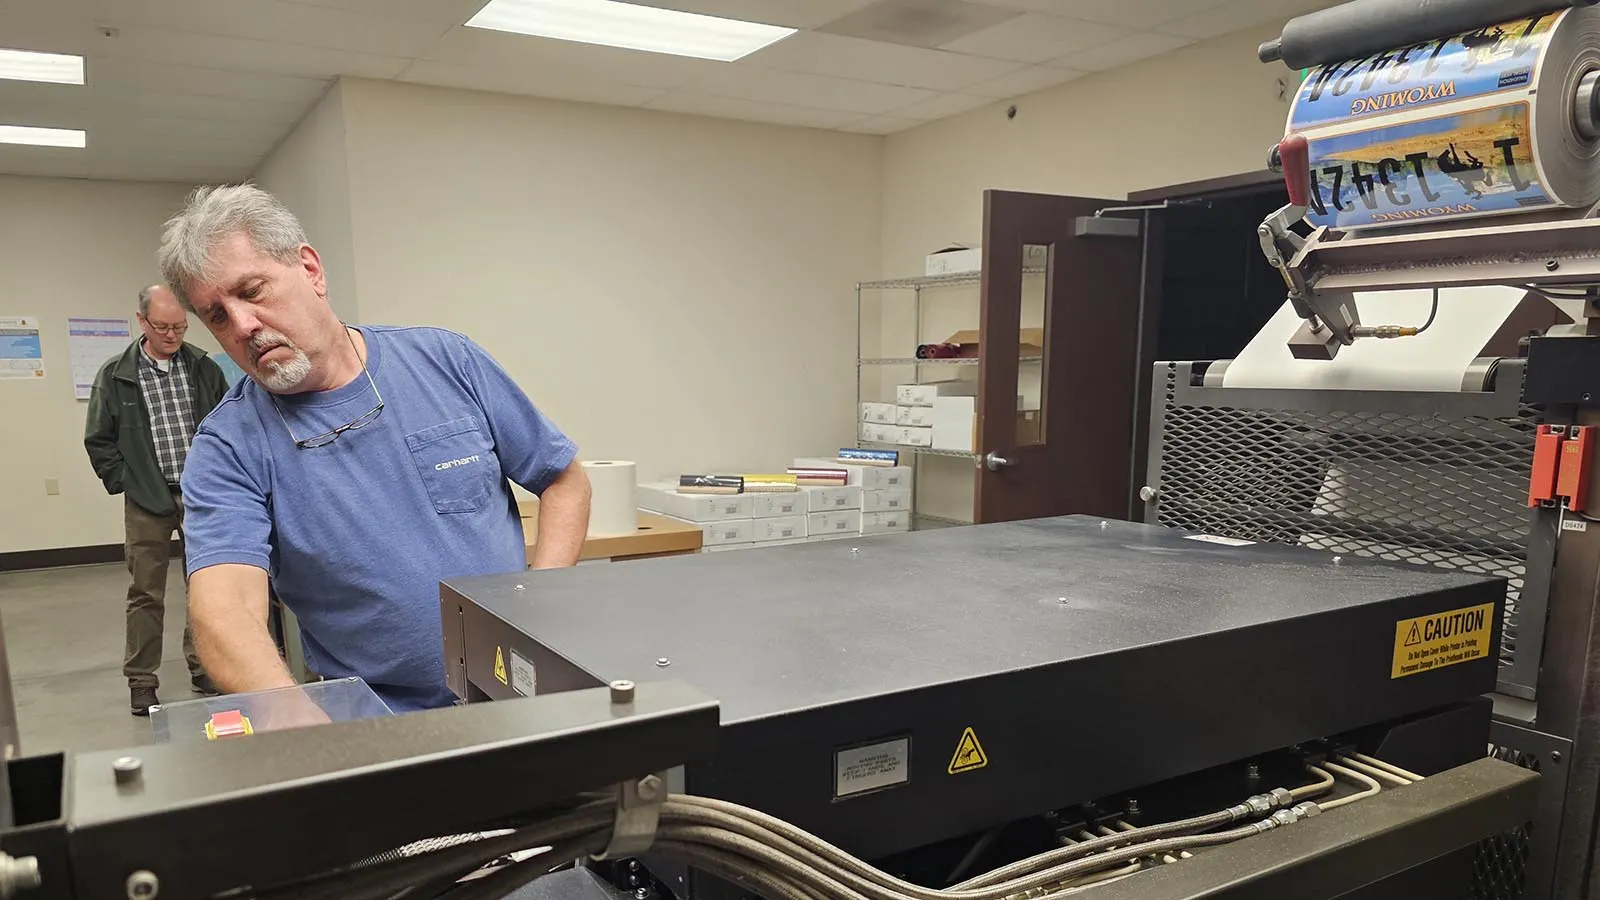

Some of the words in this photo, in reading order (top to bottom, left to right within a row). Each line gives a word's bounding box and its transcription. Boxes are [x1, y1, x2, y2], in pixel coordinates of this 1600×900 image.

[1351, 80, 1457, 115] WYOMING
[1493, 137, 1531, 192] 1
[1371, 203, 1481, 223] WYOMING
[434, 454, 480, 471] carhartt
[1424, 609, 1484, 642] CAUTION
[1421, 649, 1429, 658] Open
[1440, 645, 1449, 653] While
